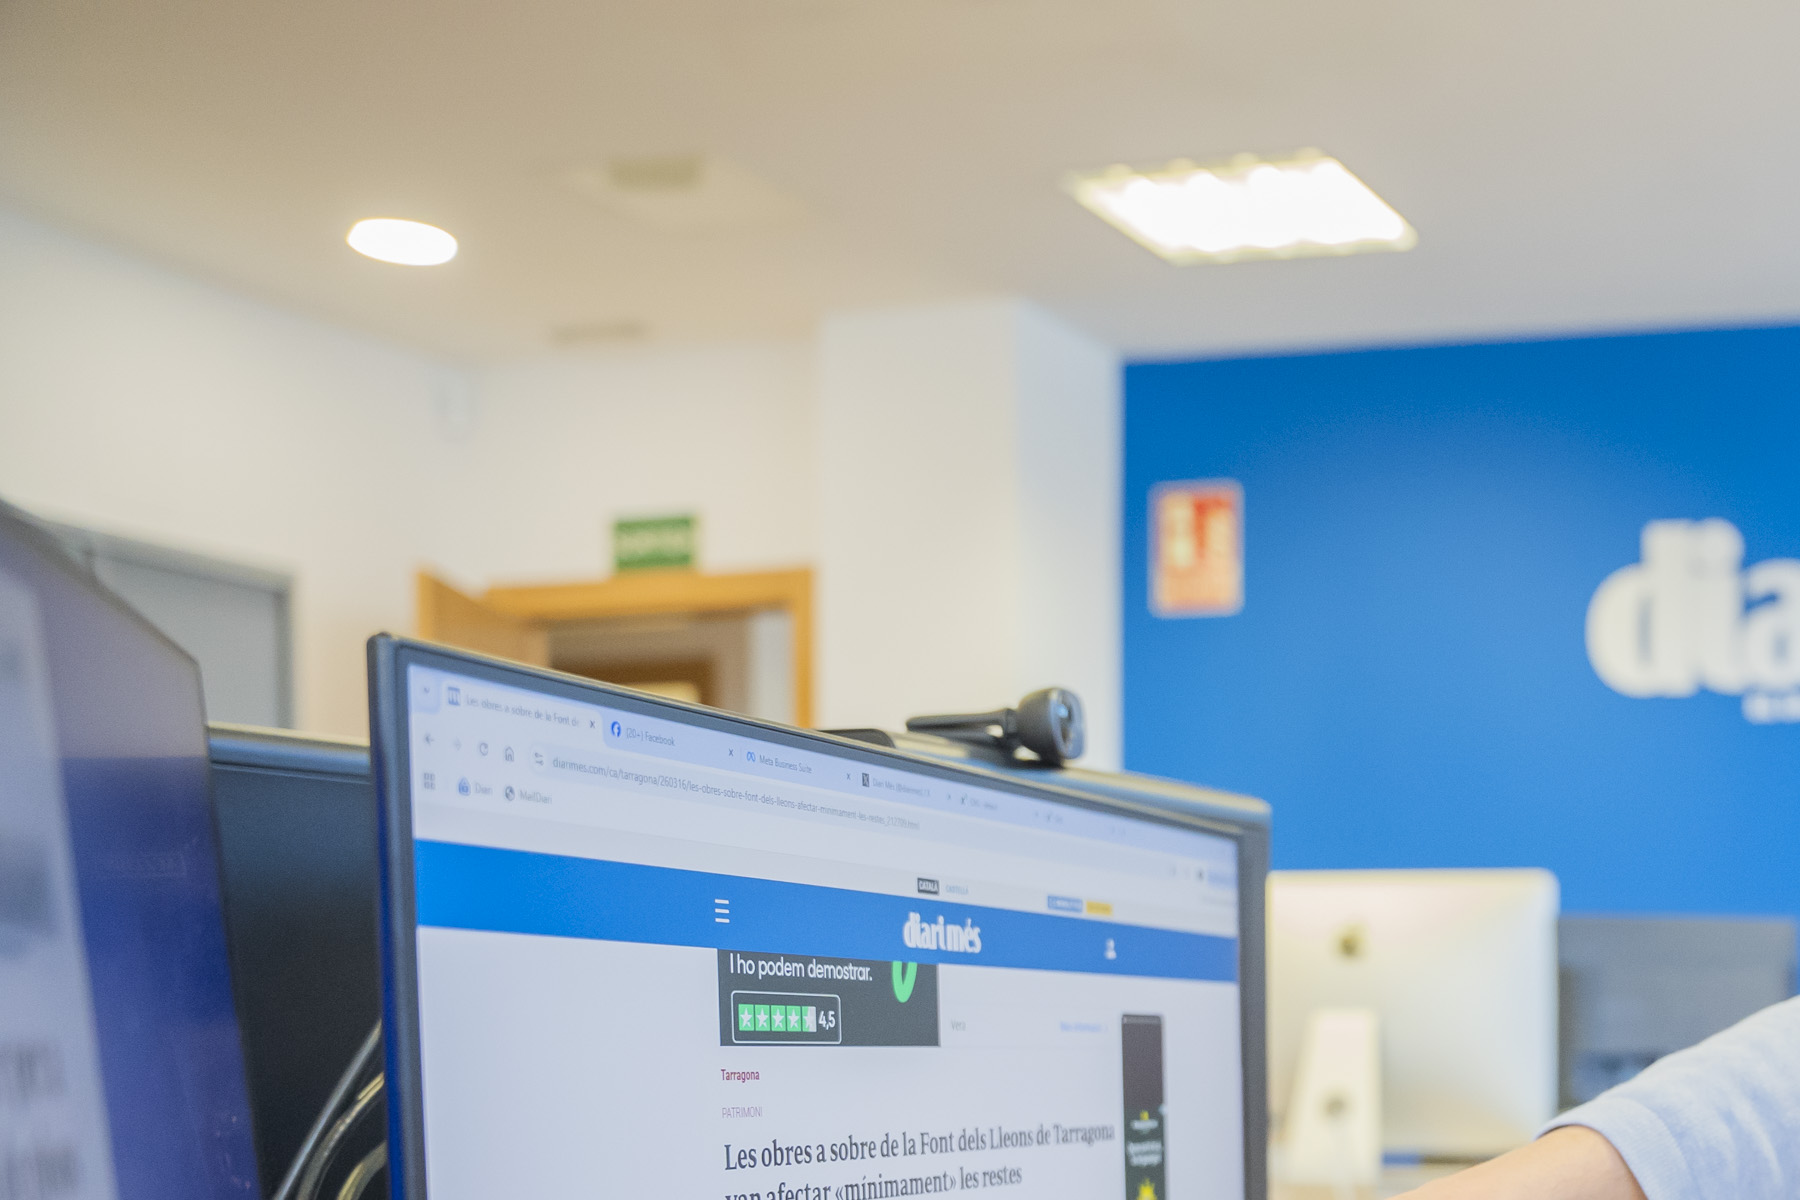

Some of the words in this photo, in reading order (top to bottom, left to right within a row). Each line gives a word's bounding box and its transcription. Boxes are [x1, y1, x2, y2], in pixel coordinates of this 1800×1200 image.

[511, 704, 533, 718] sobre
[534, 708, 544, 720] de
[553, 713, 570, 726] Font
[644, 731, 675, 747] Facebook
[759, 754, 773, 767] Meta
[774, 757, 797, 772] Business
[903, 911, 945, 950] diari
[946, 917, 982, 954] més
[737, 954, 755, 975] ho
[758, 956, 805, 980] podem
[807, 958, 873, 982] demostrar.
[818, 1010, 836, 1030] 4,5
[721, 1069, 760, 1084] Tarragona
[721, 1106, 763, 1119] PATRIMONI
[724, 1144, 758, 1171] Les
[761, 1139, 813, 1168] obres
[816, 1143, 827, 1163] a
[830, 1134, 877, 1162] sobre
[880, 1132, 899, 1158] de
[902, 1131, 917, 1156] la
[920, 1131, 955, 1155] Font
[958, 1127, 987, 1152] dels
[990, 1126, 1034, 1150] Lleons
[1036, 1123, 1051, 1145] de
[1053, 1124, 1115, 1147] Tarragona
[960, 1166, 979, 1190] les
[982, 1165, 1023, 1187] restes
